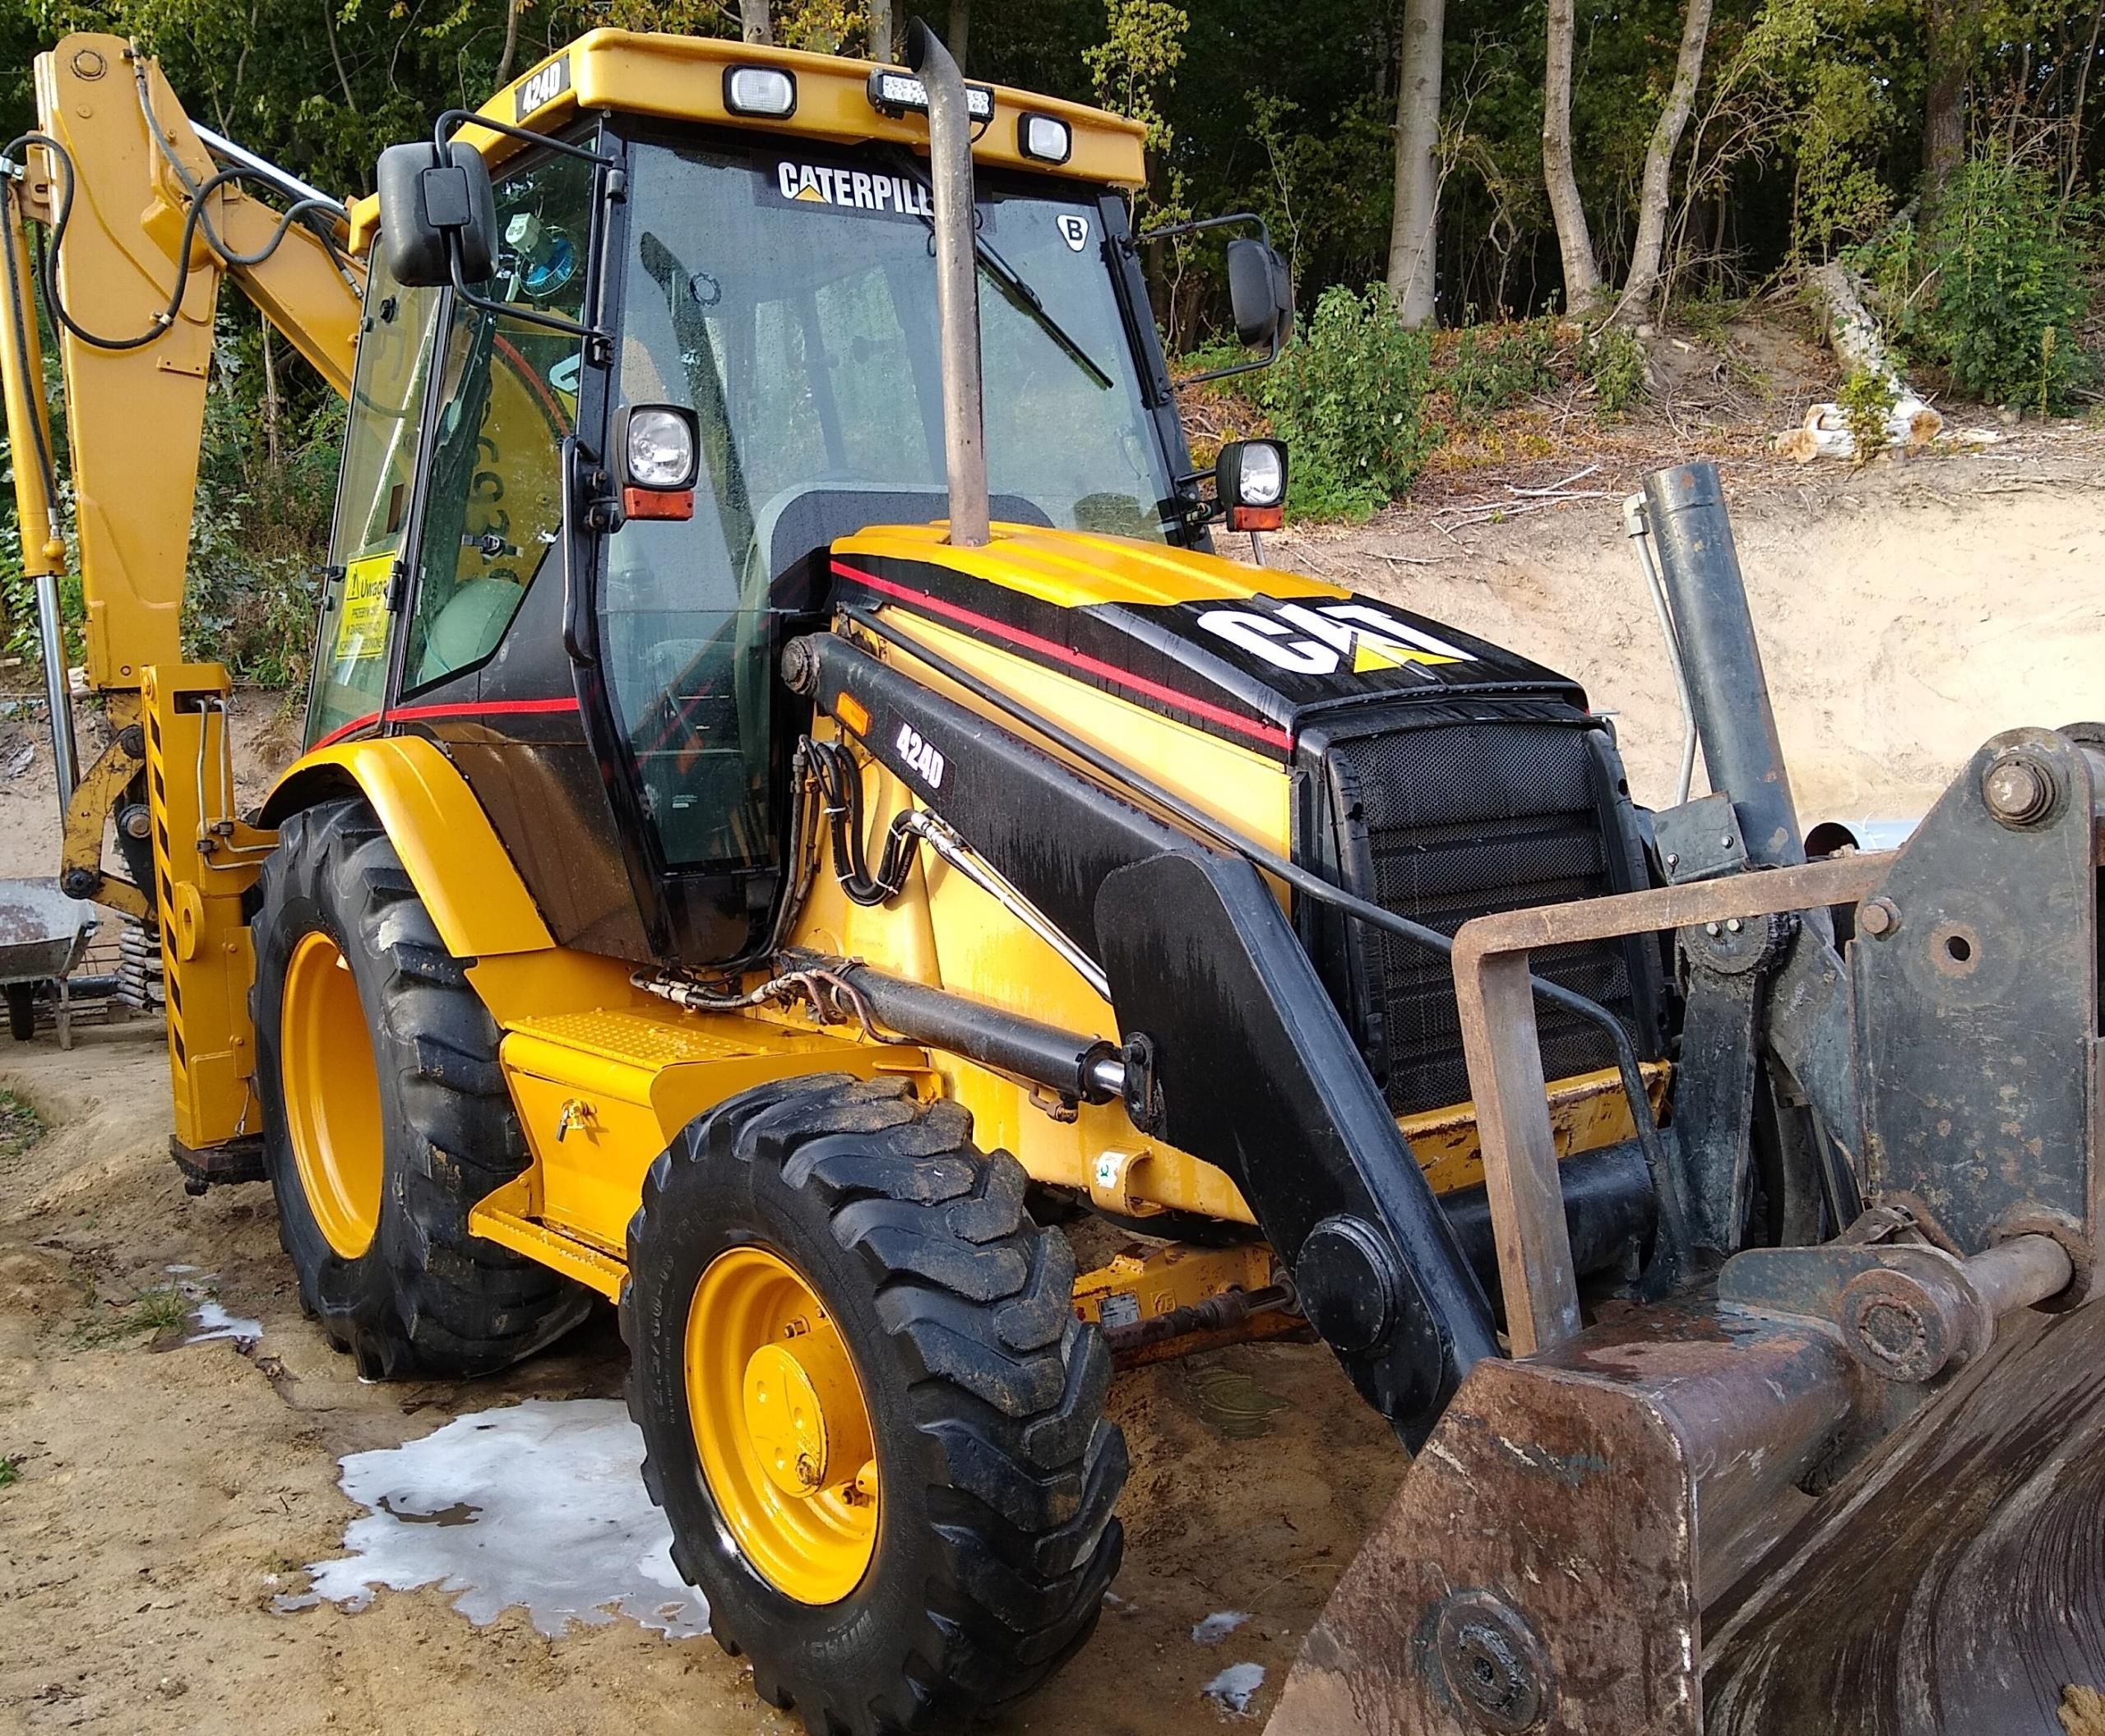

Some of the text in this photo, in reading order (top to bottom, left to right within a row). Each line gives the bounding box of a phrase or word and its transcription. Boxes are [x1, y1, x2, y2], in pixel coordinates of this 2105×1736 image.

[522, 61, 561, 113] 424D
[778, 161, 935, 217] CATERPILL
[1066, 219, 1084, 241] B
[1197, 604, 1479, 675] CAT
[896, 723, 945, 789] 424D
